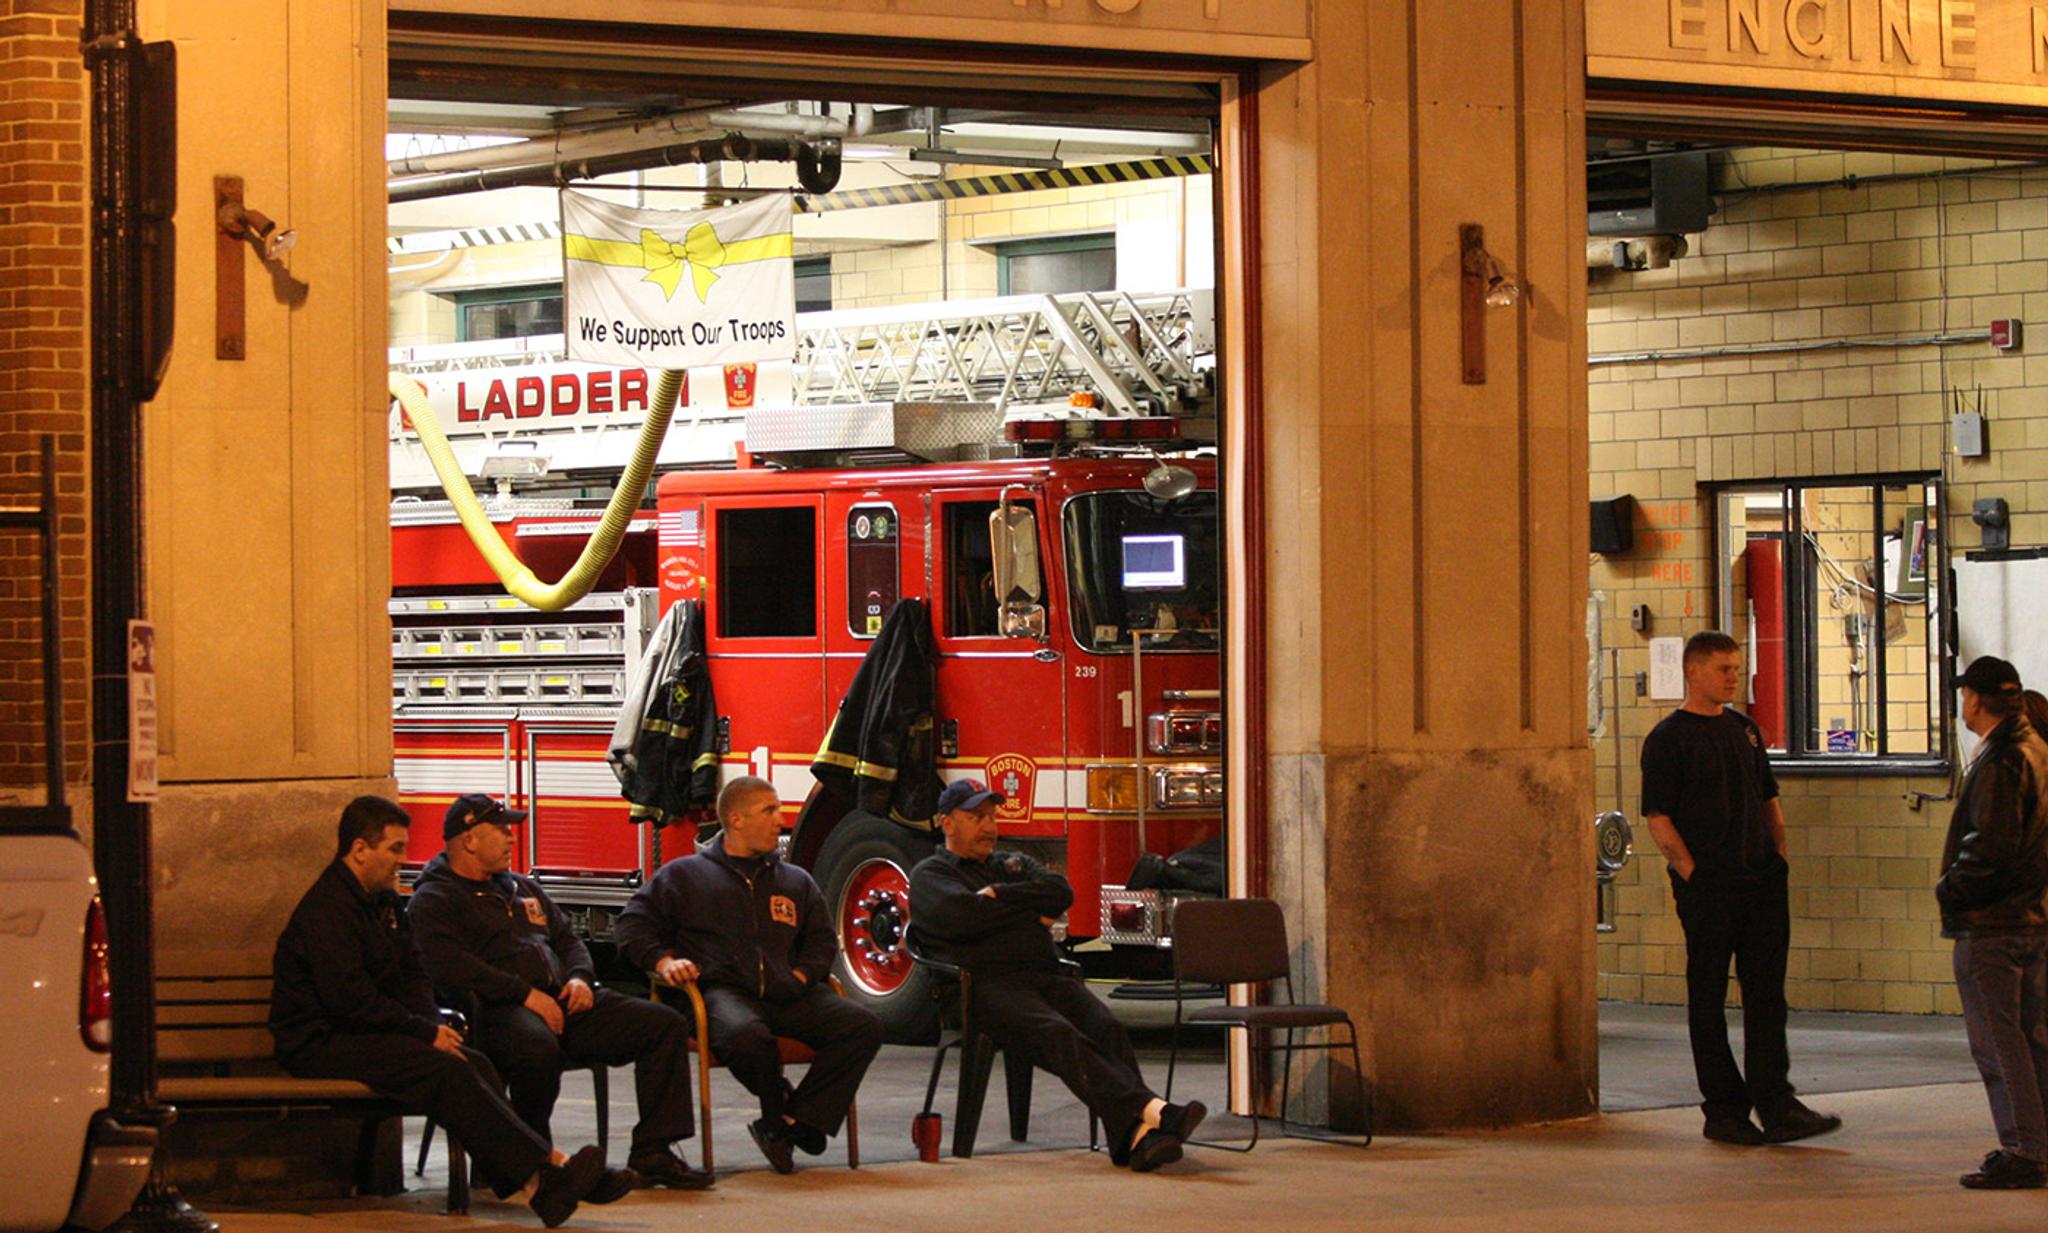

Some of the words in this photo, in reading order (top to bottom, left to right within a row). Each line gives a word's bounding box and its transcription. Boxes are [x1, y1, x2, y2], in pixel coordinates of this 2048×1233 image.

[1667, 0, 1977, 70] ENGINE
[580, 317, 607, 342] We
[613, 320, 685, 351] Support
[692, 322, 722, 345] Our
[729, 319, 785, 343] Troops
[457, 368, 648, 422] LADDER
[1643, 531, 1682, 552] STOP
[1652, 562, 1694, 584] HERE
[1075, 666, 1097, 678] 239
[1117, 690, 1133, 728] 1
[750, 745, 769, 780] 1
[991, 758, 1031, 777] BOSTON
